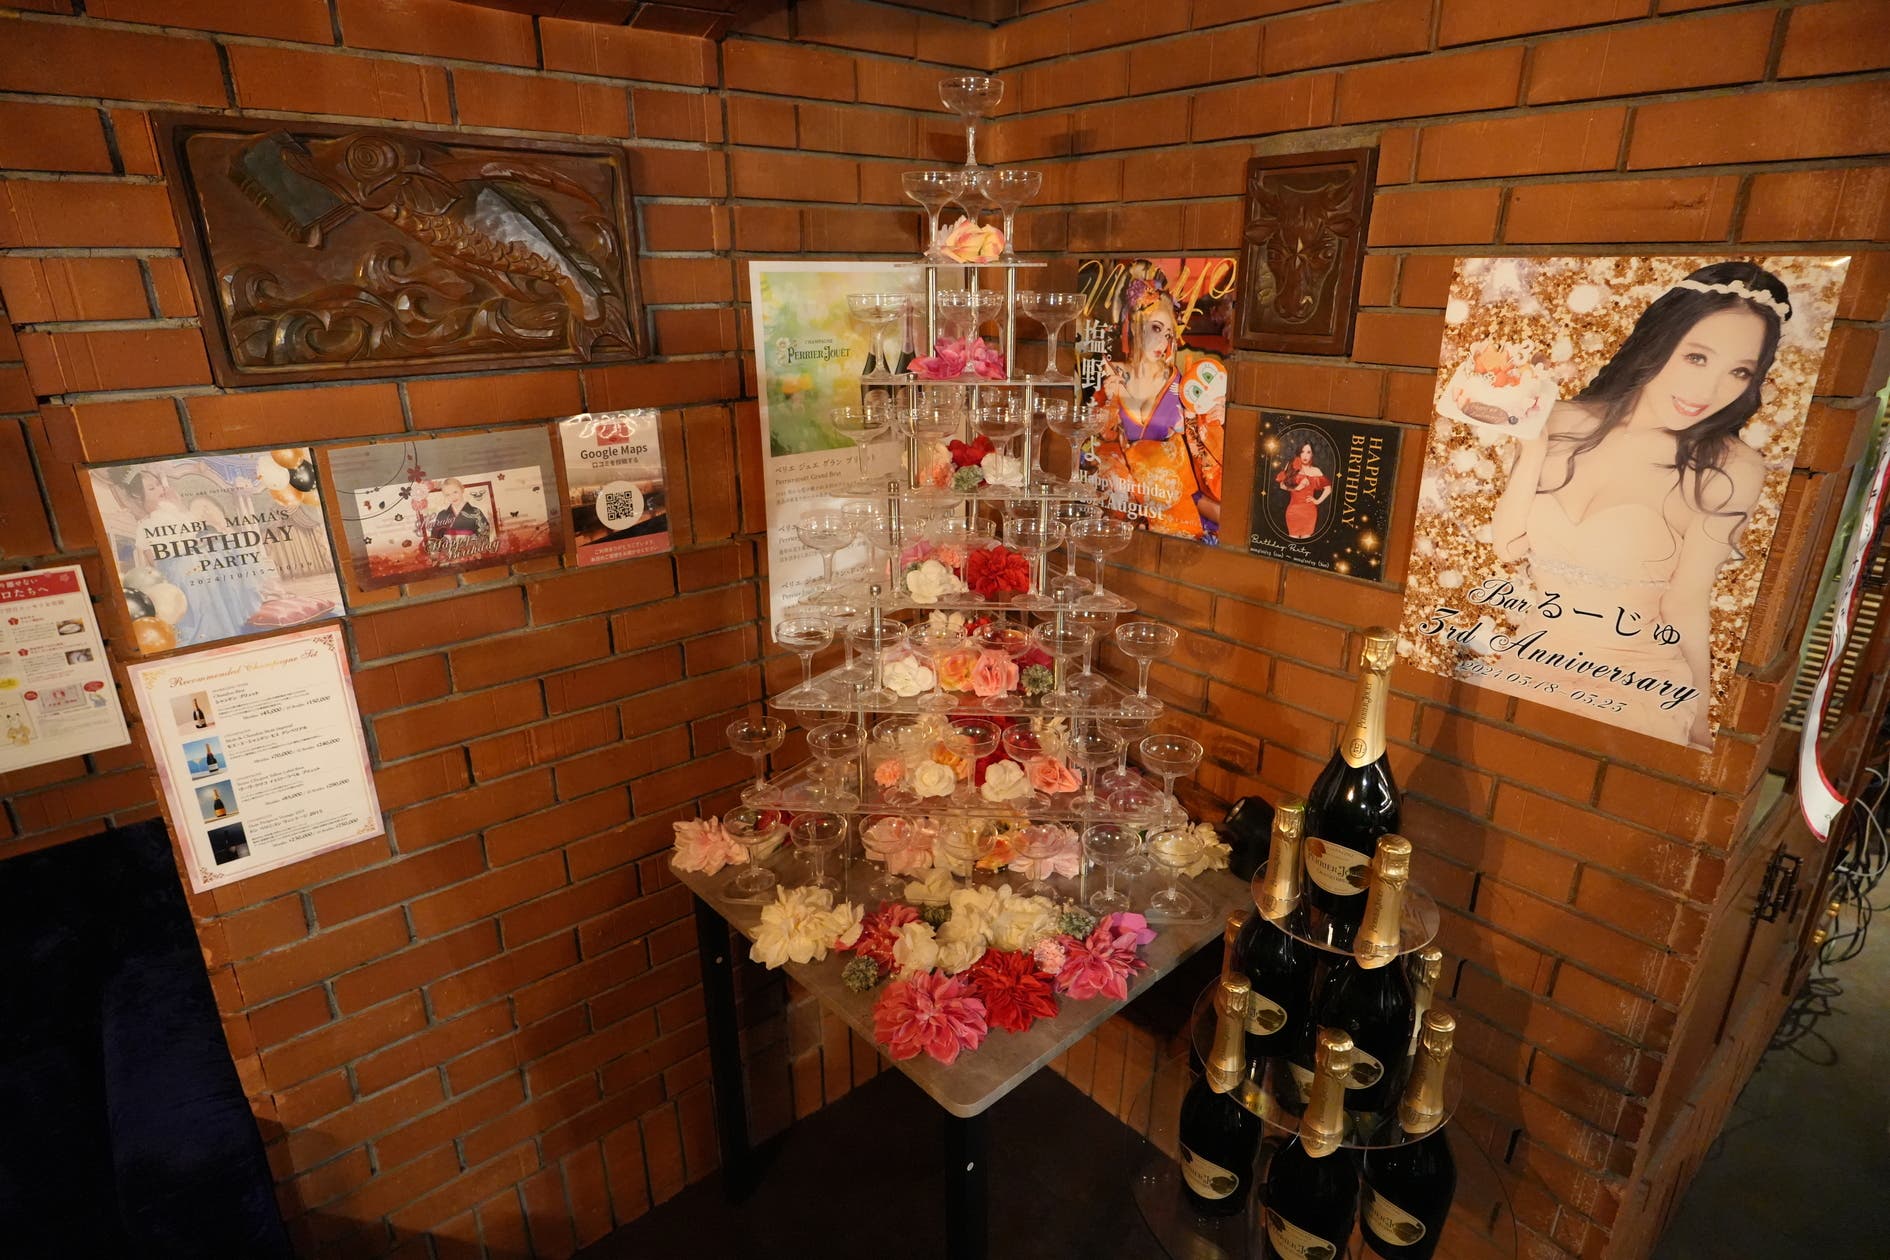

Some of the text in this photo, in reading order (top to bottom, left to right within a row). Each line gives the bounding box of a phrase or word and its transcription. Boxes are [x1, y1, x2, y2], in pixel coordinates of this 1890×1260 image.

[580, 444, 649, 460] Google Maps
[1362, 436, 1384, 500] HAPPY
[1118, 476, 1175, 504] Birthday
[1341, 433, 1366, 529] BIRTHDAY
[143, 509, 290, 539] MIYABI MAMA'S
[150, 524, 294, 561] BIRTHDAY
[199, 551, 261, 572] PARTY
[1251, 533, 1287, 551] Birthday
[1288, 543, 1312, 557] Party
[1467, 577, 1682, 647] Bar. るーじゅ
[169, 667, 242, 689] Recommended
[243, 657, 299, 673] Champagne
[300, 649, 320, 661] Set
[1417, 607, 1702, 710] 3rd Anniversary
